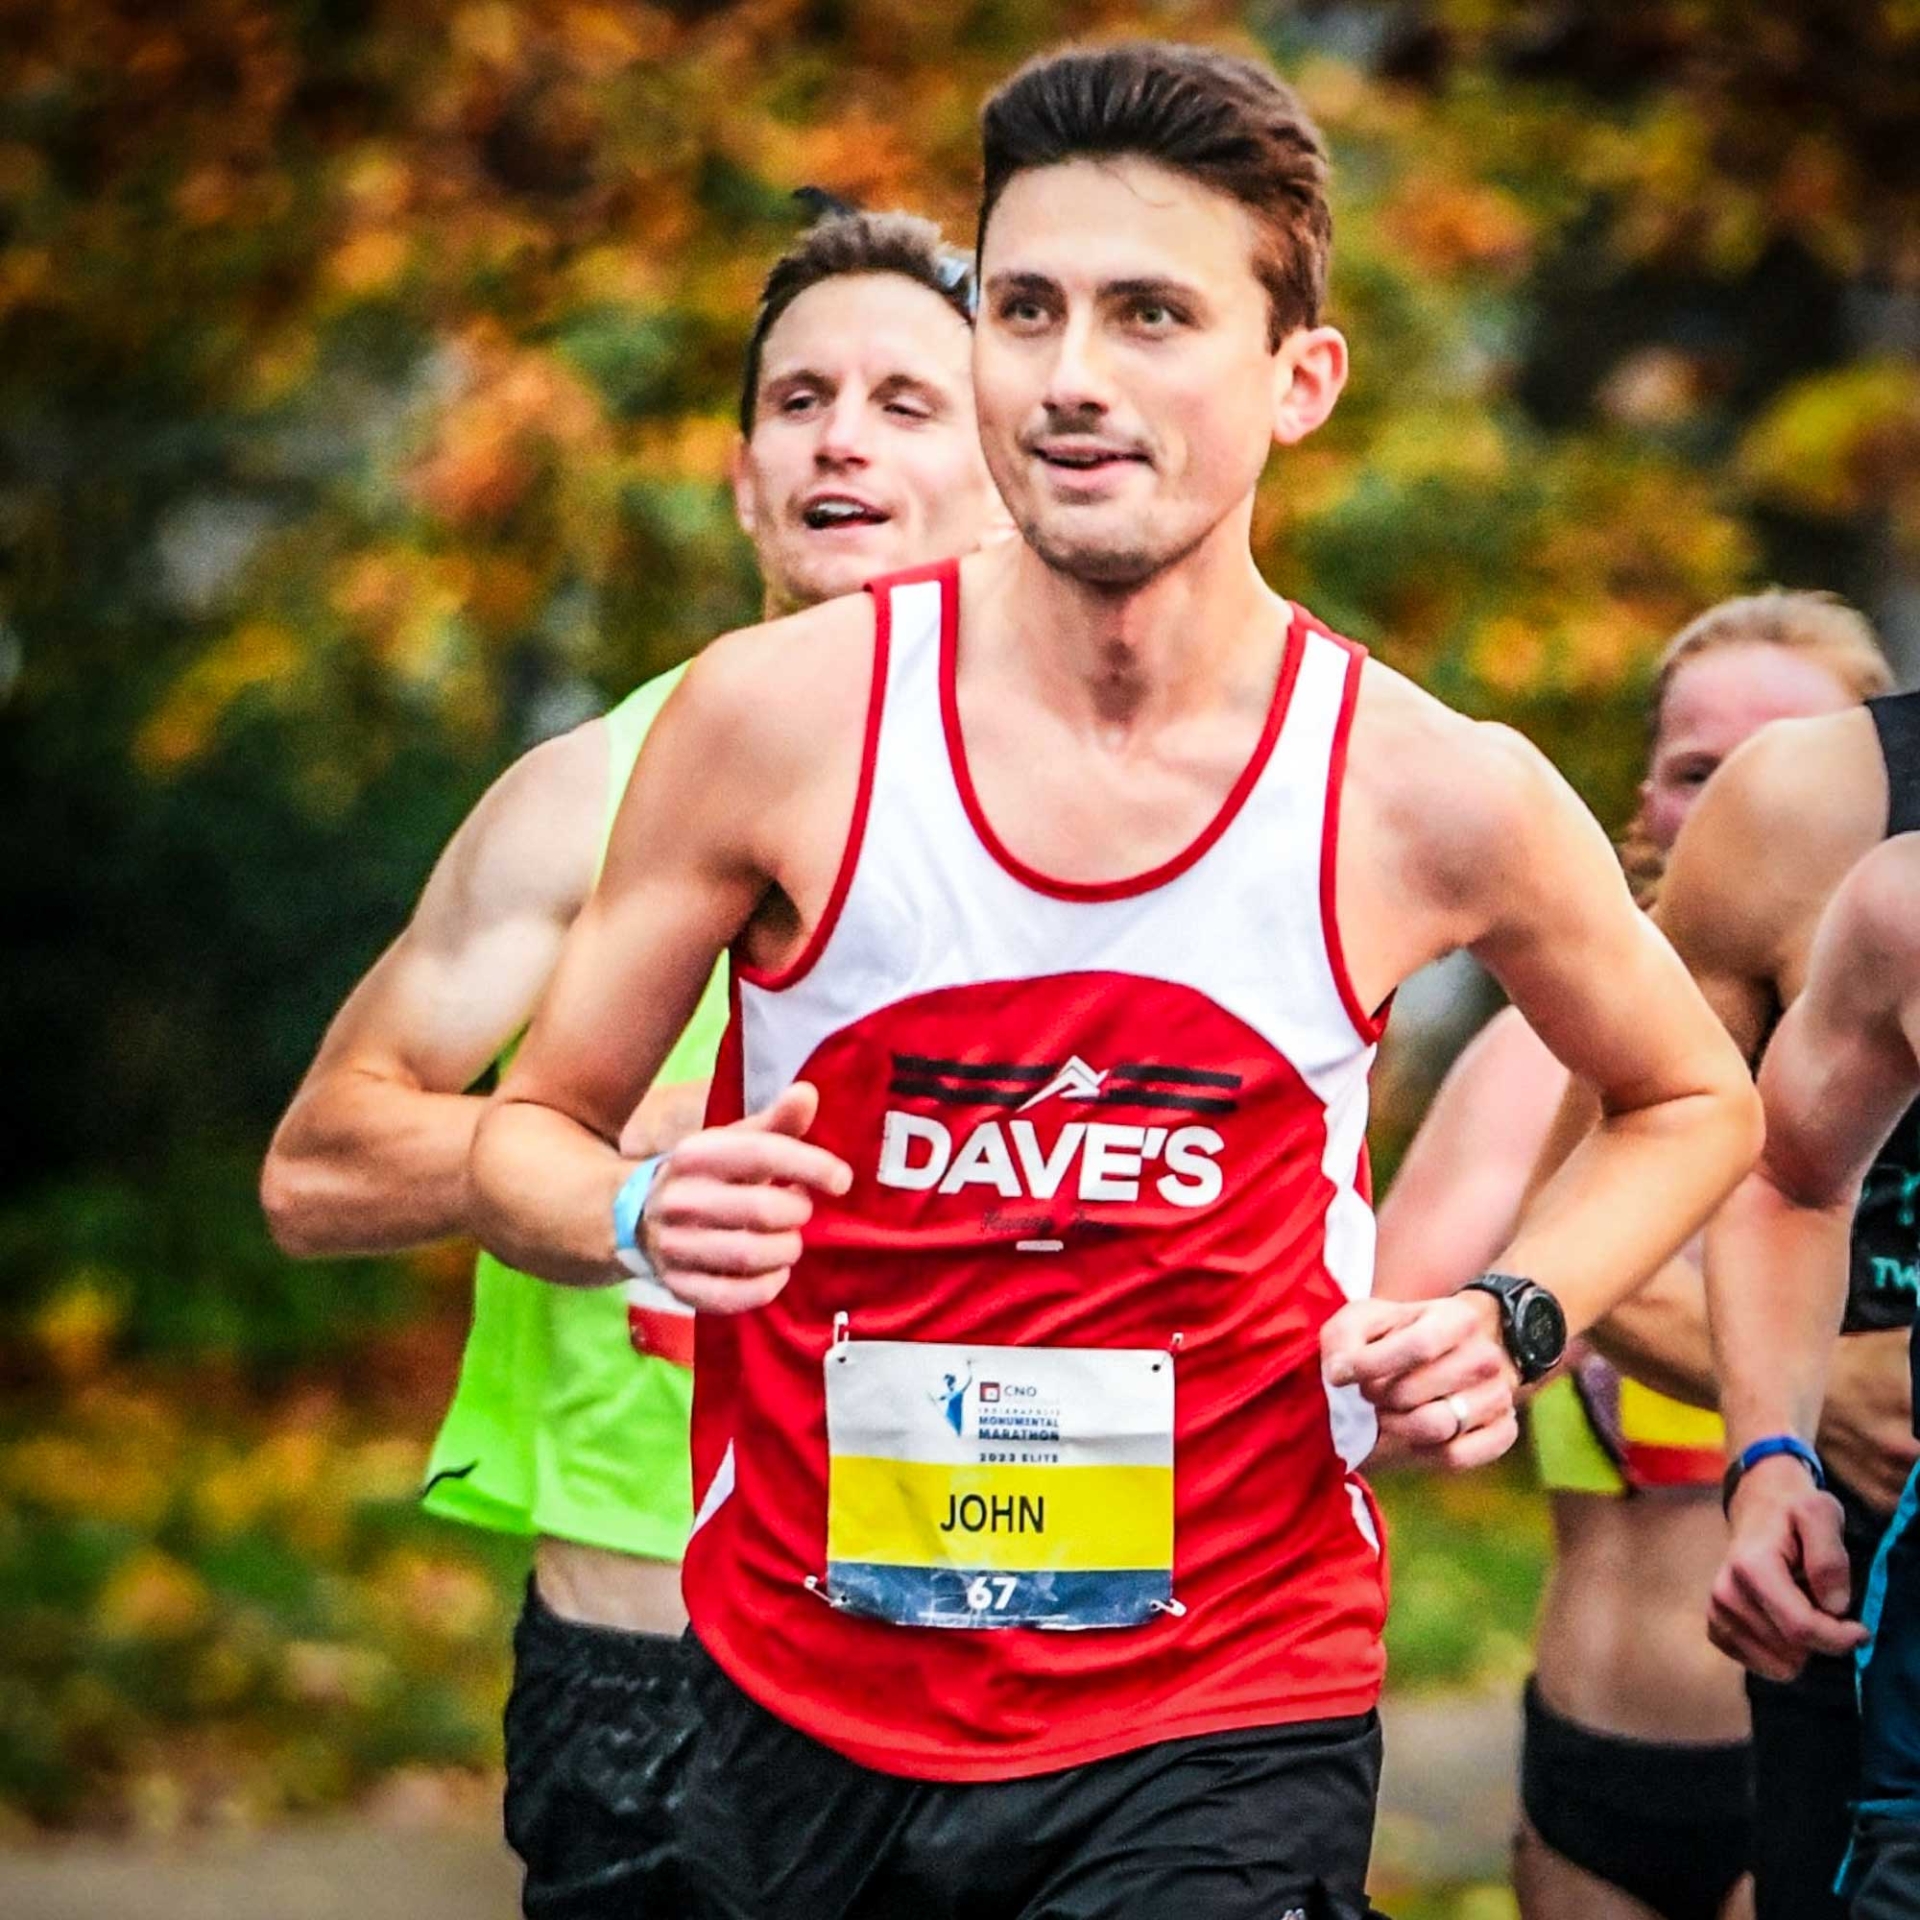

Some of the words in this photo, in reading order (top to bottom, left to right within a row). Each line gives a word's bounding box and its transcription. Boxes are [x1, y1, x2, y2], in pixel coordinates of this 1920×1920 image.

[876, 1110, 1225, 1207] DAVE'S
[1004, 1385, 1037, 1397] CNO
[979, 1416, 1059, 1427] MONUMENTAL
[979, 1428, 1059, 1441] MARATHON
[980, 1453, 1016, 1462] 2023
[1022, 1453, 1058, 1463] ELITE
[940, 1494, 1044, 1533] JOHN
[967, 1576, 1018, 1610] 67
